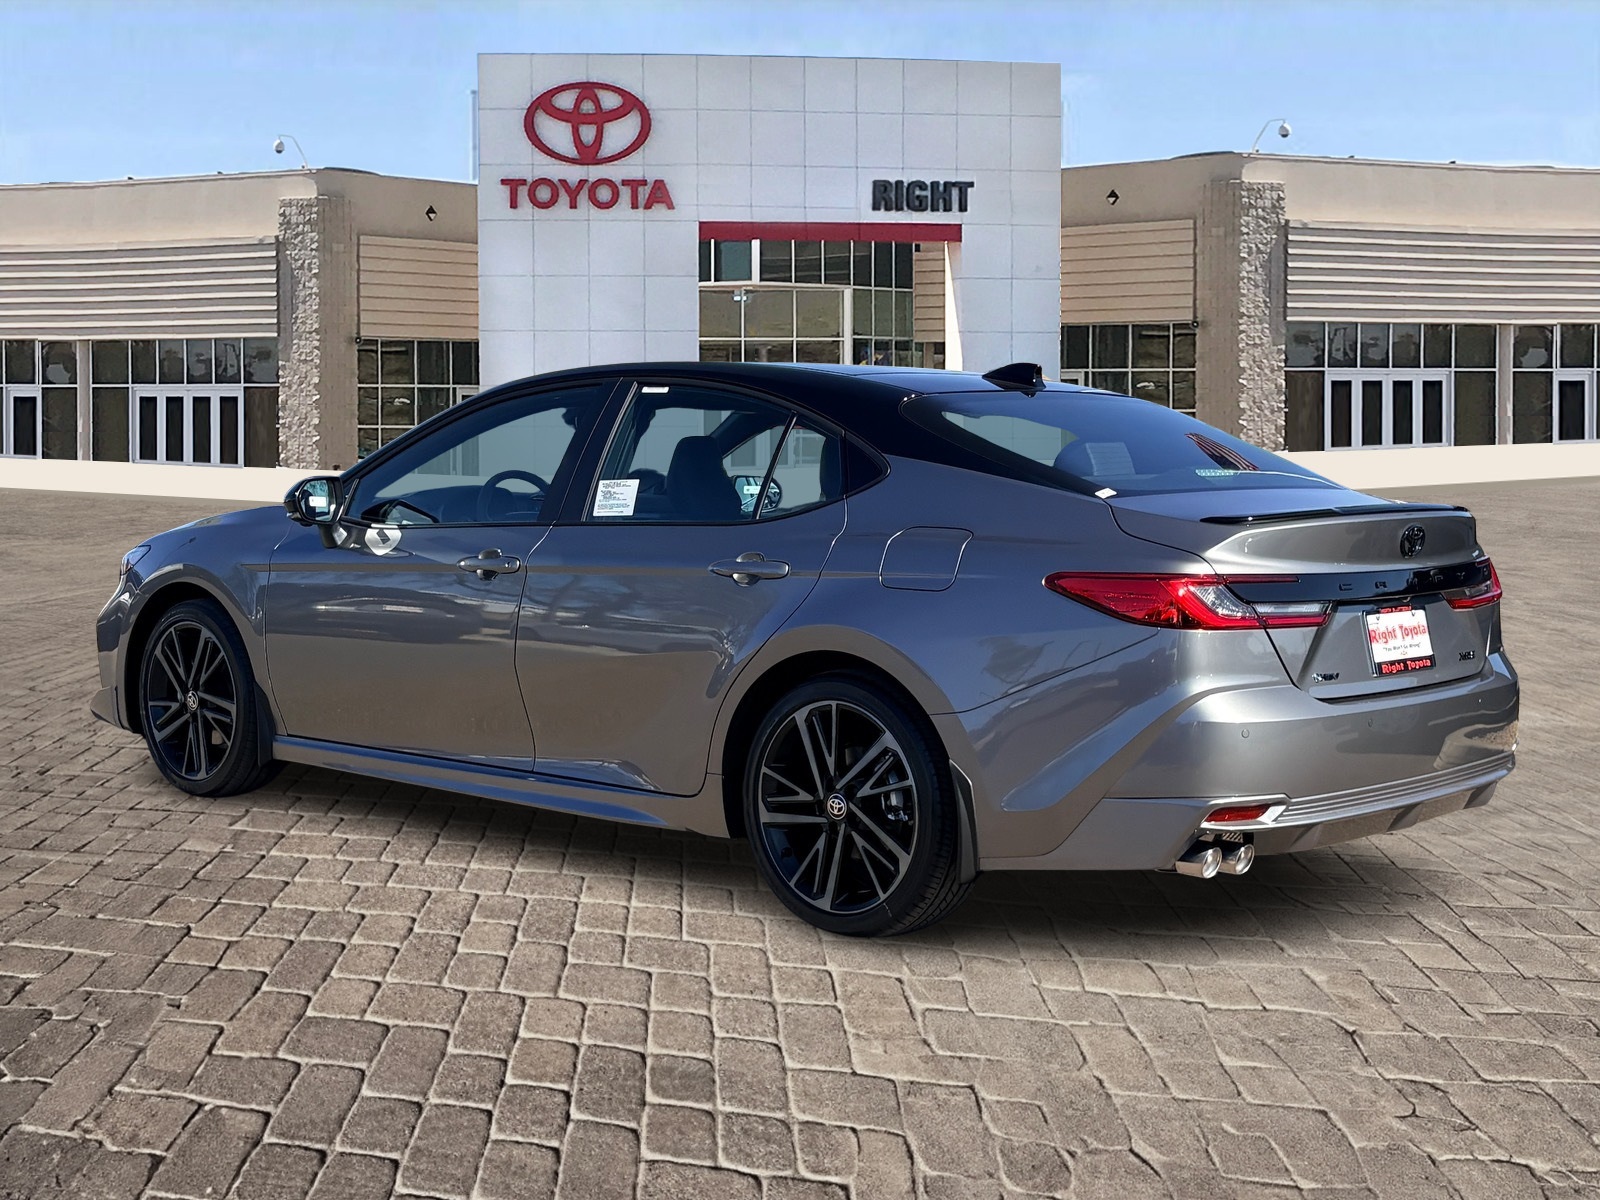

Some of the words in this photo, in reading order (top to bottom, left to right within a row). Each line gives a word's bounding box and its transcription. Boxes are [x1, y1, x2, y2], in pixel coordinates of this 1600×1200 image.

[500, 178, 674, 210] TOYOTA
[871, 178, 975, 213] RIGHT
[1369, 626, 1397, 645] Right
[1398, 622, 1427, 641] Toyota
[1381, 662, 1404, 674] Right
[1406, 659, 1431, 671] Toyota
